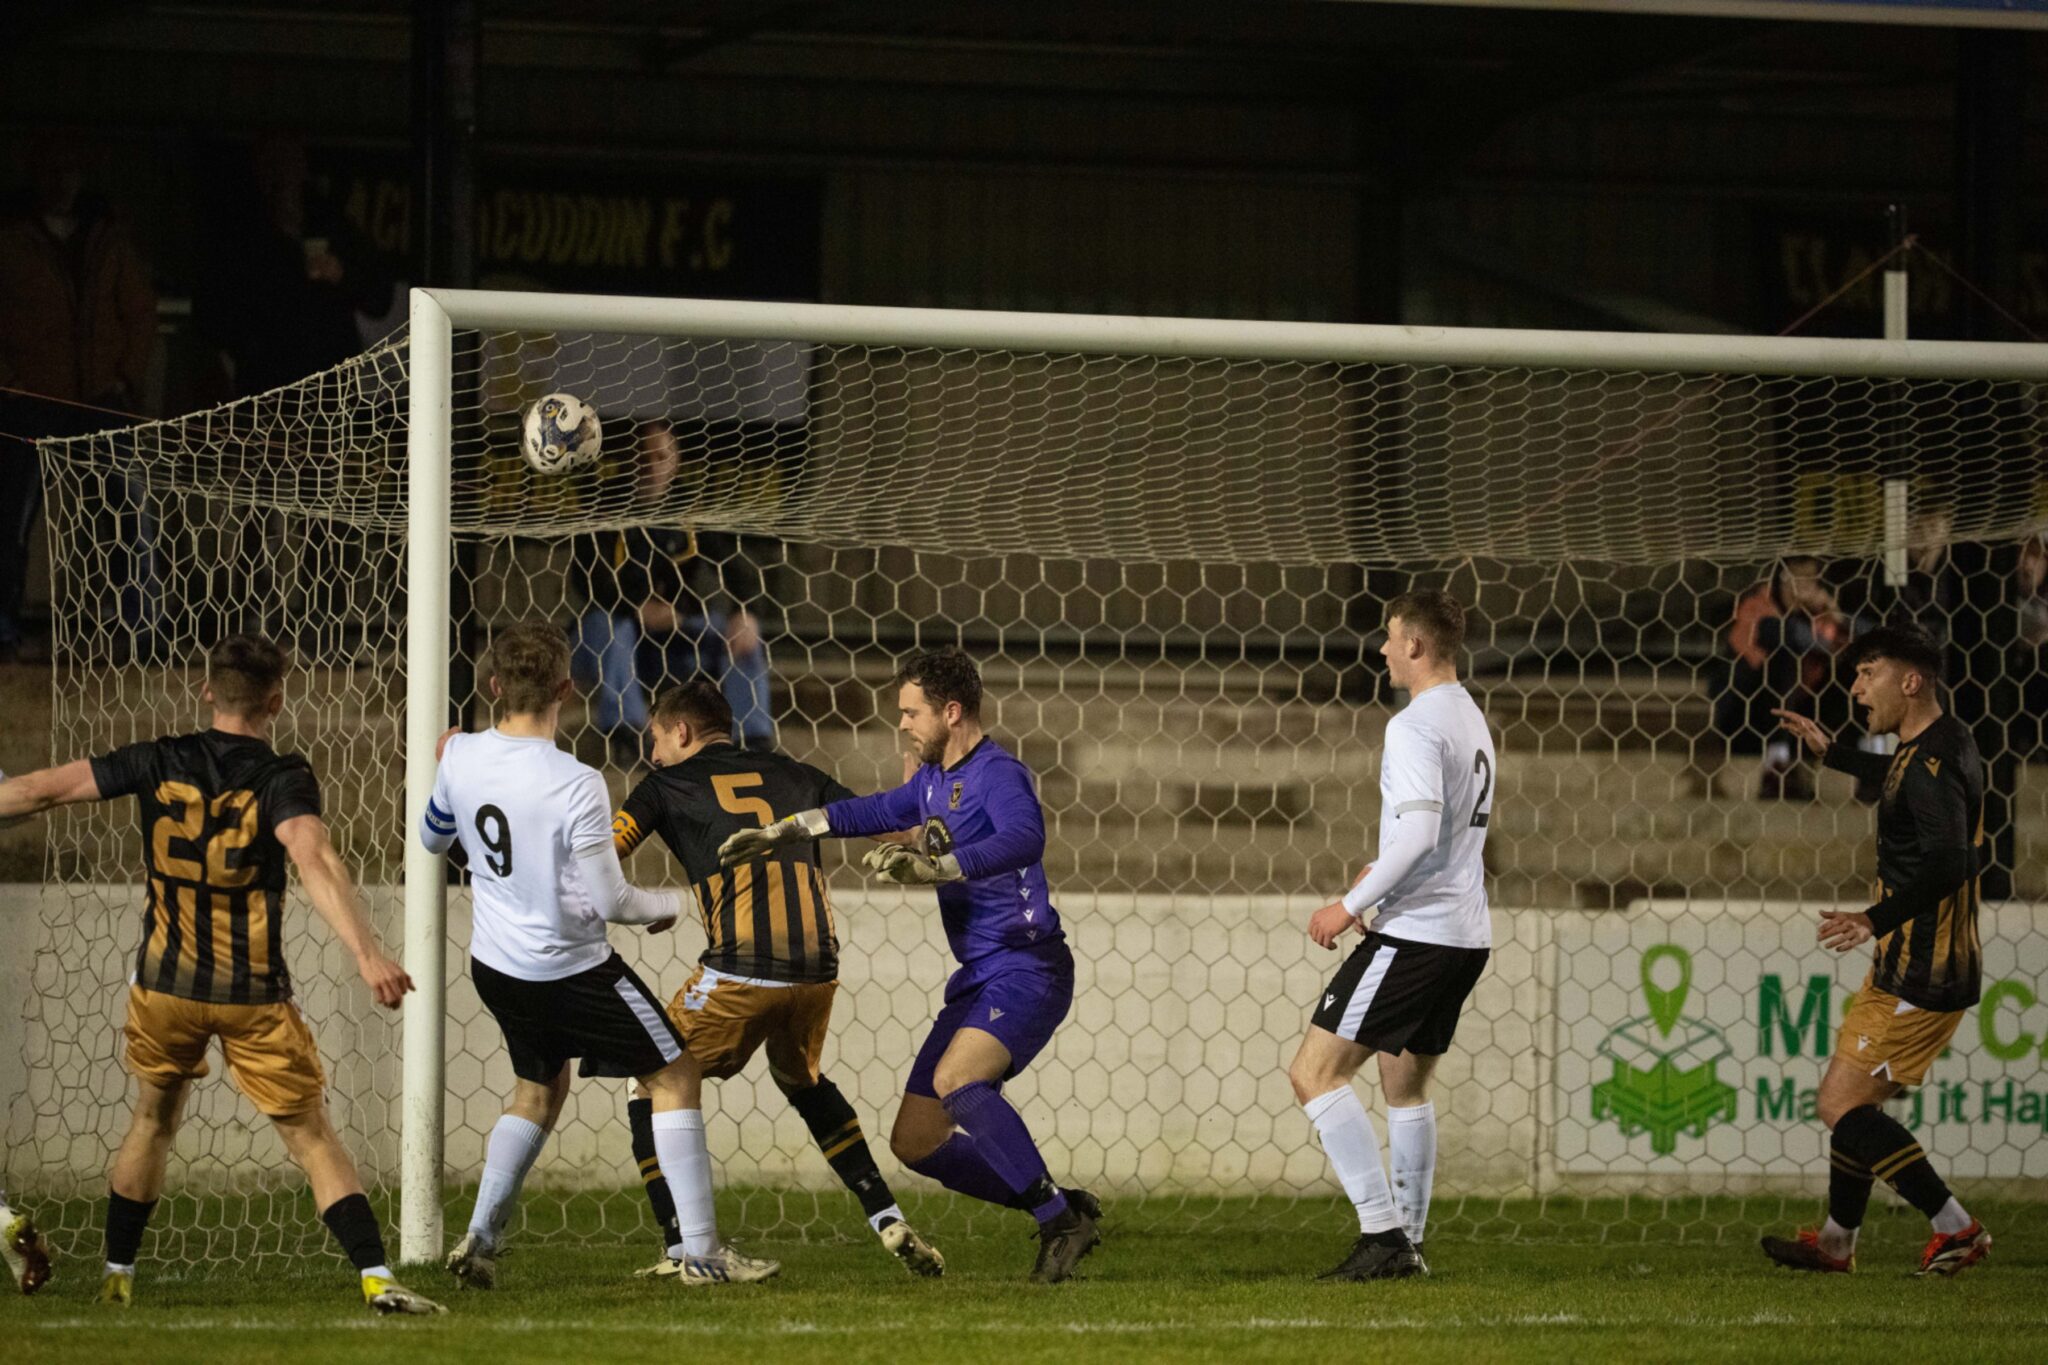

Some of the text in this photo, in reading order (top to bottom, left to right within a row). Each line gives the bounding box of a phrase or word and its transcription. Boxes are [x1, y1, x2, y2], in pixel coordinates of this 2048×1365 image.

[710, 772, 775, 856] 5
[1469, 749, 1491, 828] 2
[153, 780, 259, 888] 22
[475, 804, 512, 877] 9
[1938, 1080, 1967, 1124] it
[1982, 1079, 2048, 1132] Ha
